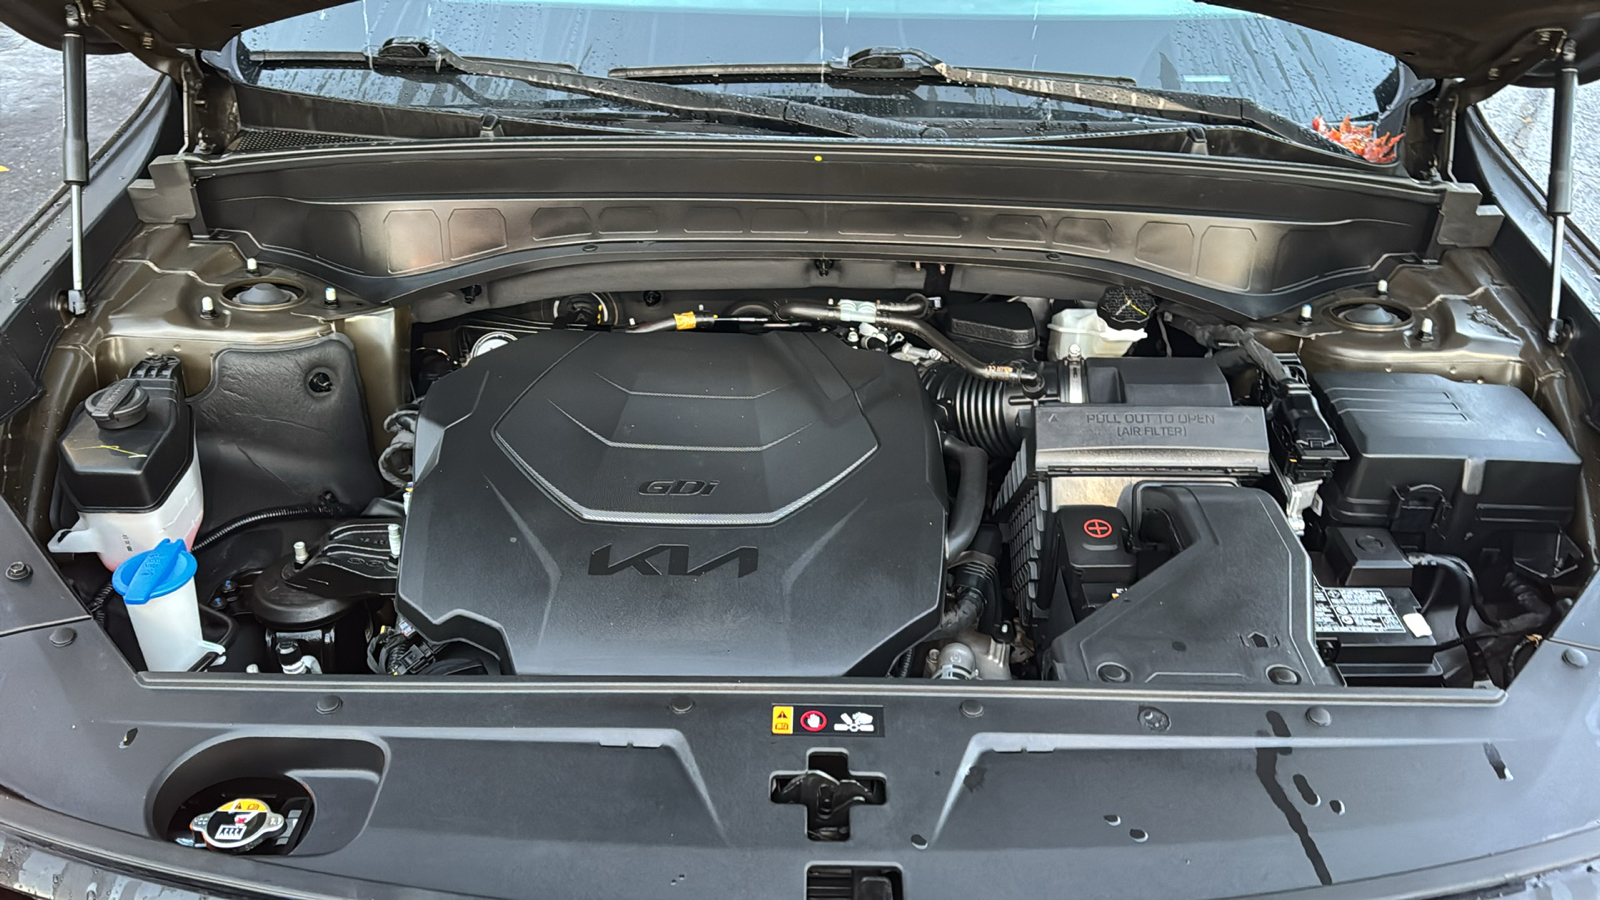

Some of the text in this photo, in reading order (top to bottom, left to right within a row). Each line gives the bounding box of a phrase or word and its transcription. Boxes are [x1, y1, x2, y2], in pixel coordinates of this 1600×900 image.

[1086, 413, 1216, 425] PULL OUT TO OPEN
[1117, 426, 1187, 437] (AIR FILTER)
[638, 479, 720, 497] GDi
[588, 543, 760, 578] KIA
